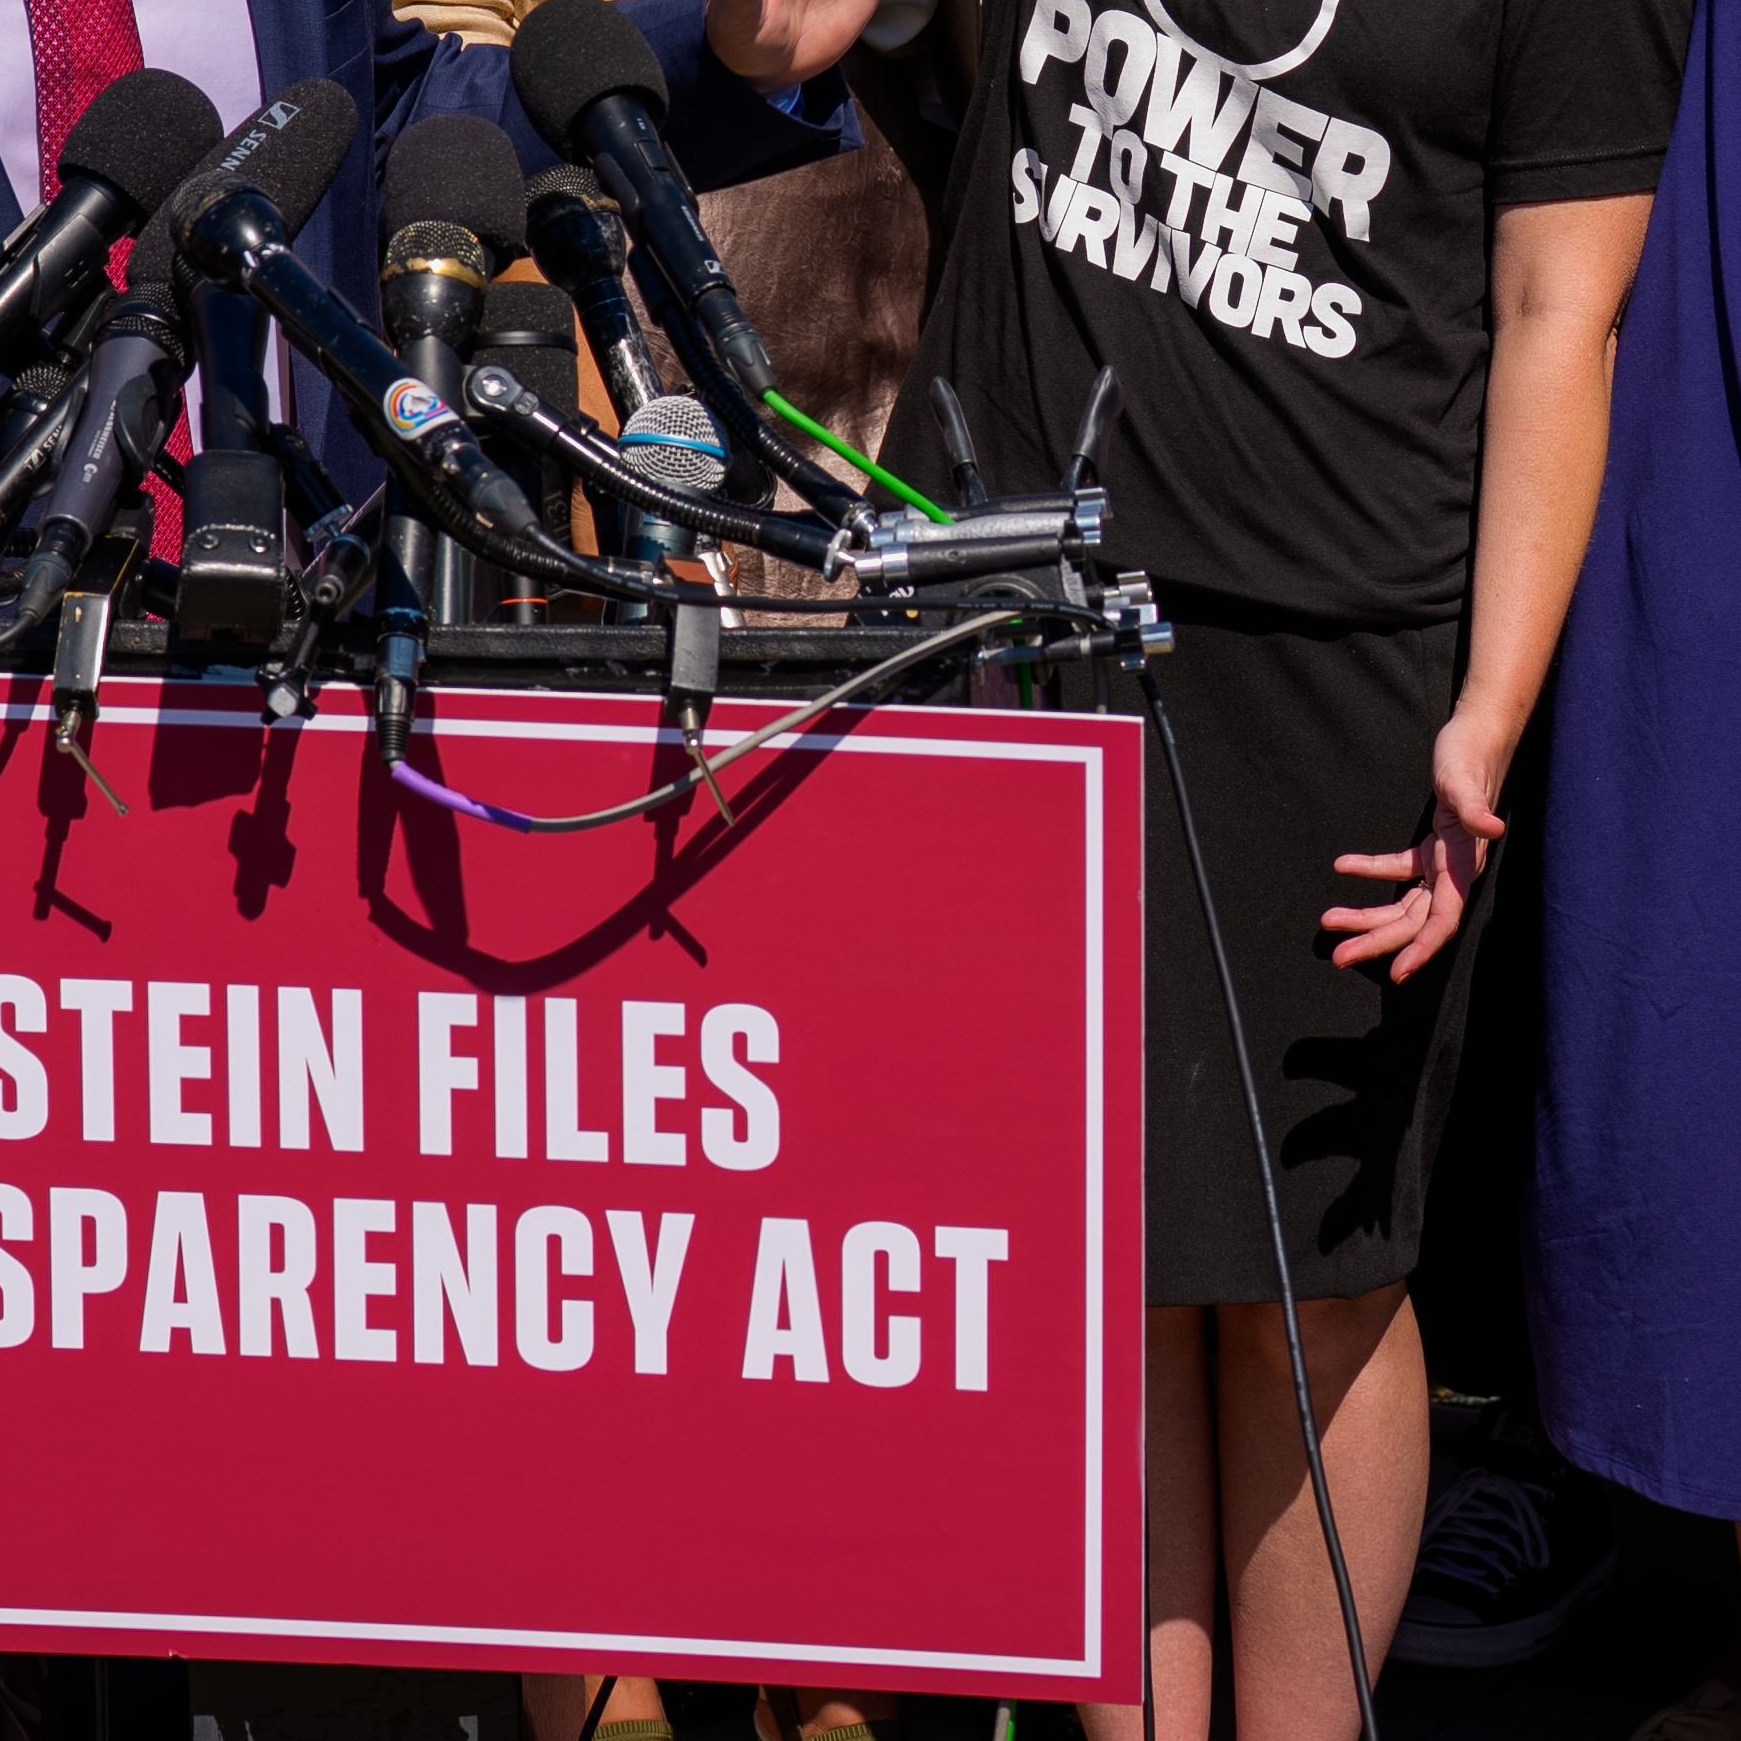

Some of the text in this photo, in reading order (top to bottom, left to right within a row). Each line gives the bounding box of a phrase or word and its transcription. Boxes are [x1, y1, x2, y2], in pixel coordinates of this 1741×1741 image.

[218, 129, 267, 171] SENN
[1068, 103, 1314, 271] TO THE
[1012, 148, 1362, 358] SURVIVORS
[418, 991, 780, 1171] FILES
[742, 1217, 1009, 1392] ACT
